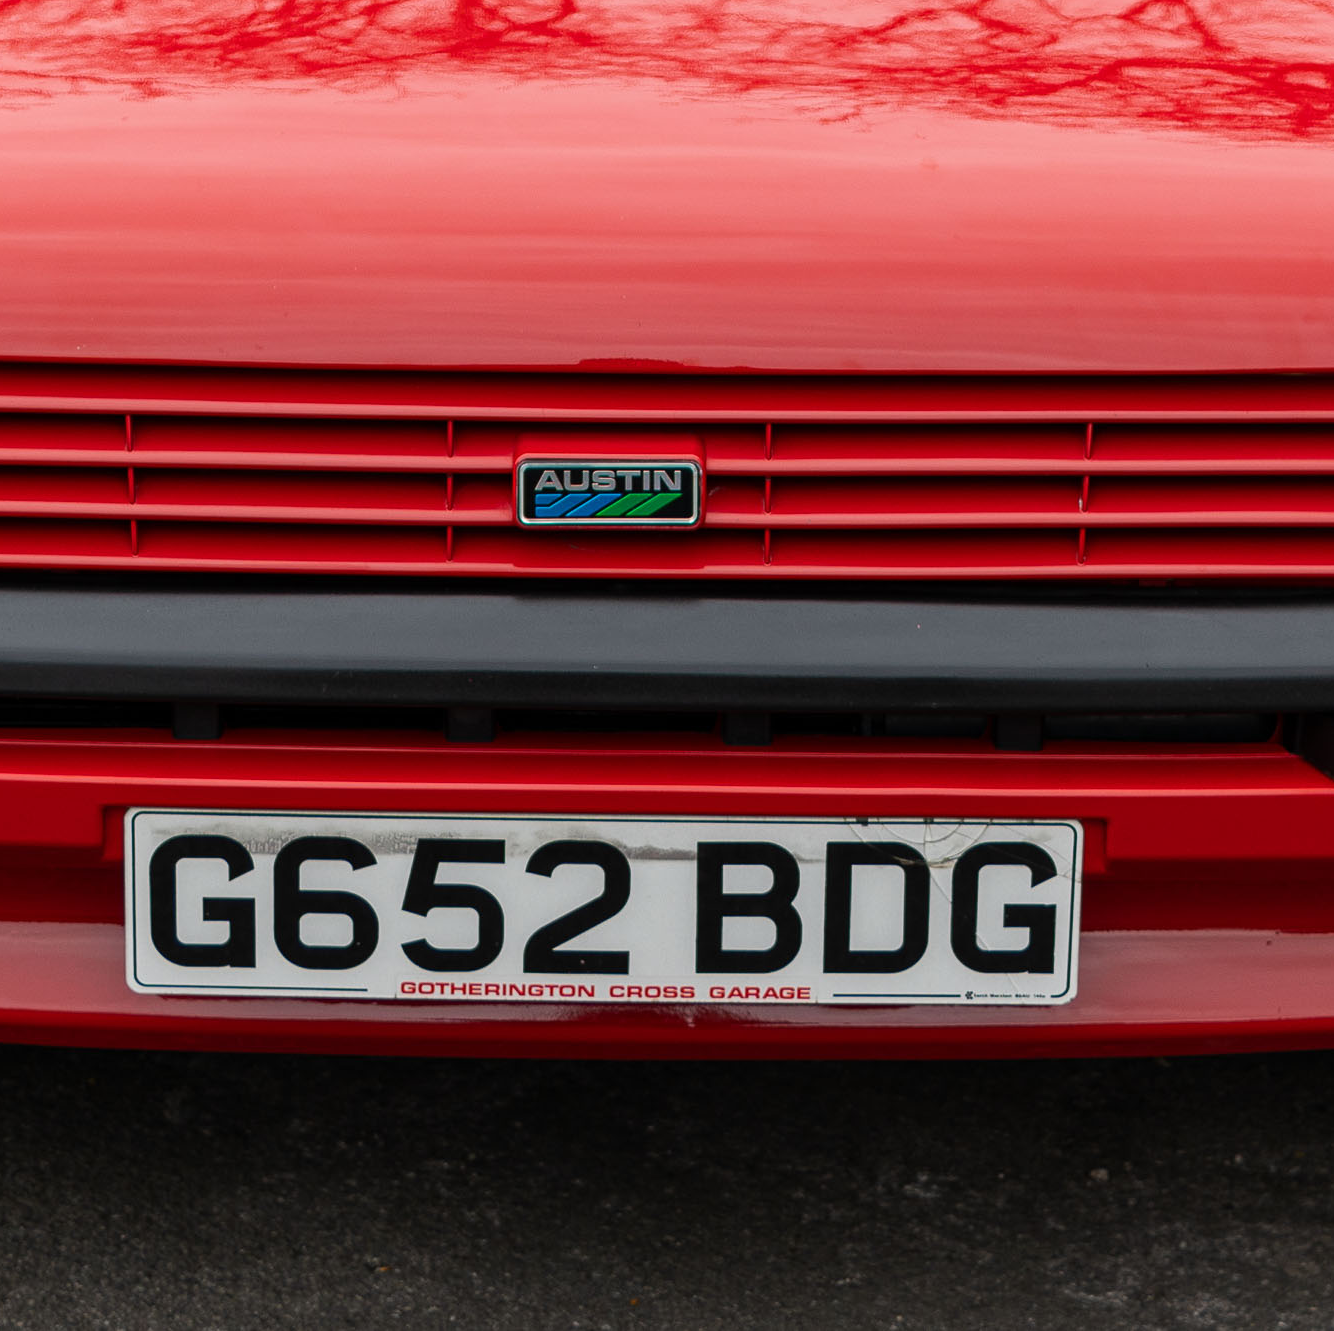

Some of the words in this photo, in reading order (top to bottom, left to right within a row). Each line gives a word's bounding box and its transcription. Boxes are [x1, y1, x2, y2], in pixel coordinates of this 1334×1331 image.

[534, 469, 682, 492] AUSTIN
[149, 834, 631, 976] G652
[695, 841, 1058, 975] BDG
[400, 981, 596, 998] GOTHERINGTON
[608, 984, 696, 1000] CROSS
[708, 985, 811, 1000] GARAGE
